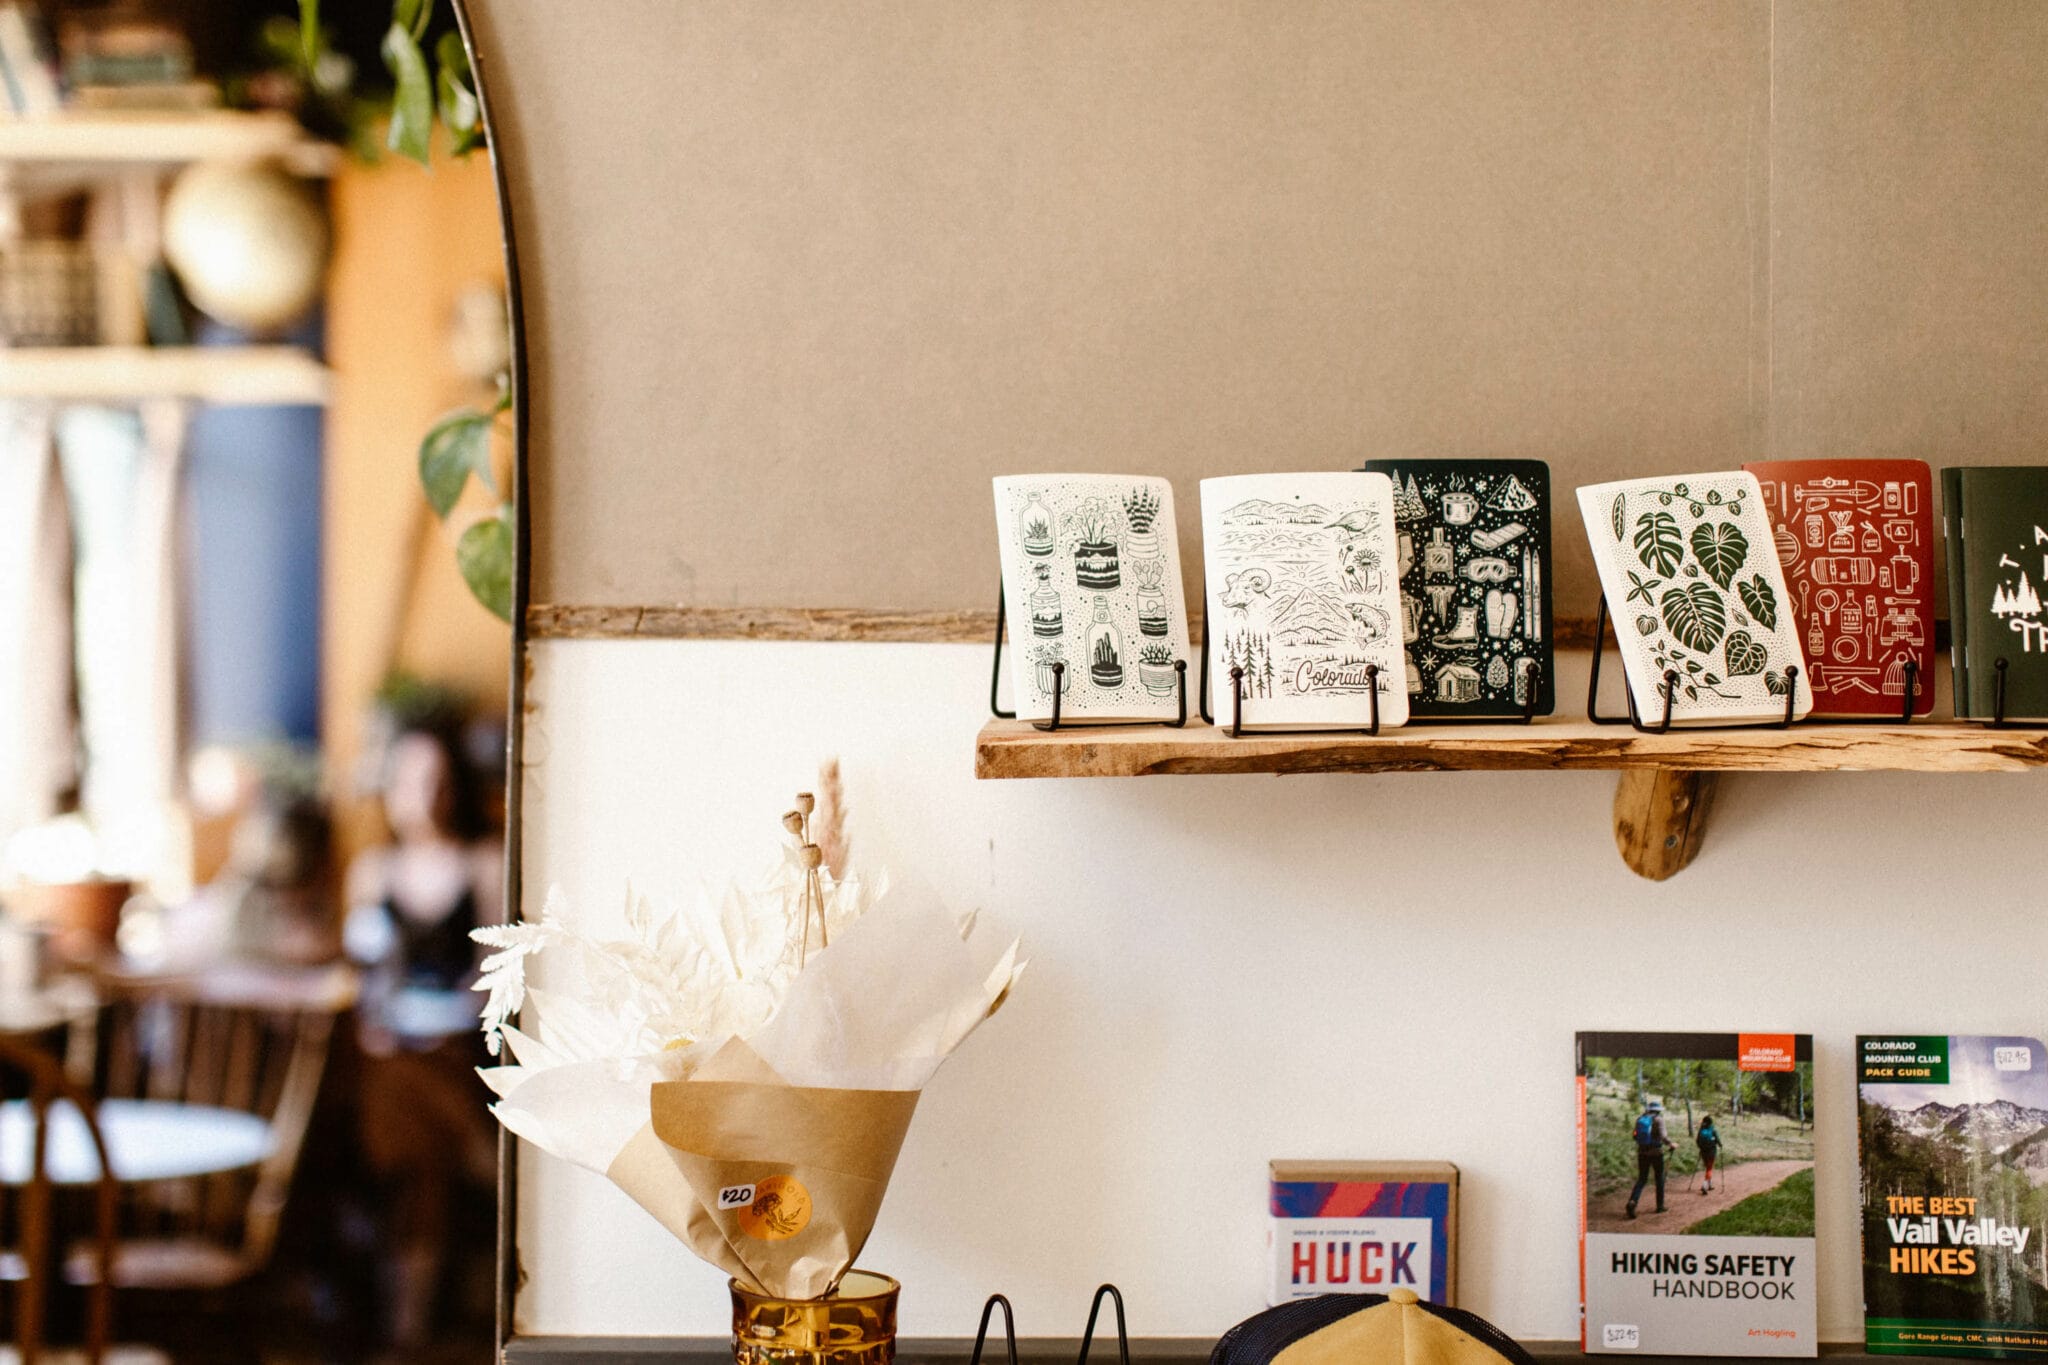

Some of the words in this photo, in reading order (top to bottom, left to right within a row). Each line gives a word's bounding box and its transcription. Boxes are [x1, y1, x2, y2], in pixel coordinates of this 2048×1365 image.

[1296, 660, 1371, 692] Colorado
[1865, 1042, 1916, 1050] COLORADO
[1865, 1055, 1915, 1063] MOUNTAIN
[1917, 1055, 1941, 1063] CLUB
[1866, 1068, 1894, 1076] PACK
[1898, 1068, 1930, 1076] GUIDE
[722, 1188, 751, 1203] $20
[1887, 1196, 1924, 1214] THE
[1930, 1197, 1977, 1215] BEST
[1887, 1217, 1939, 1244] Vail
[1944, 1218, 2030, 1254] Valley
[1292, 1242, 1417, 1284] HUCK
[1612, 1252, 1698, 1275] HIKING
[1705, 1255, 1795, 1277] SAFETY
[1890, 1248, 1976, 1275] HIKES
[1653, 1279, 1795, 1300] HANDBOOK
[1748, 1329, 1760, 1337] Art
[1763, 1329, 1796, 1339] Hogling
[1917, 1333, 1939, 1342] Range
[1987, 1335, 2003, 1343] with
[2005, 1336, 2031, 1344] Nathan
